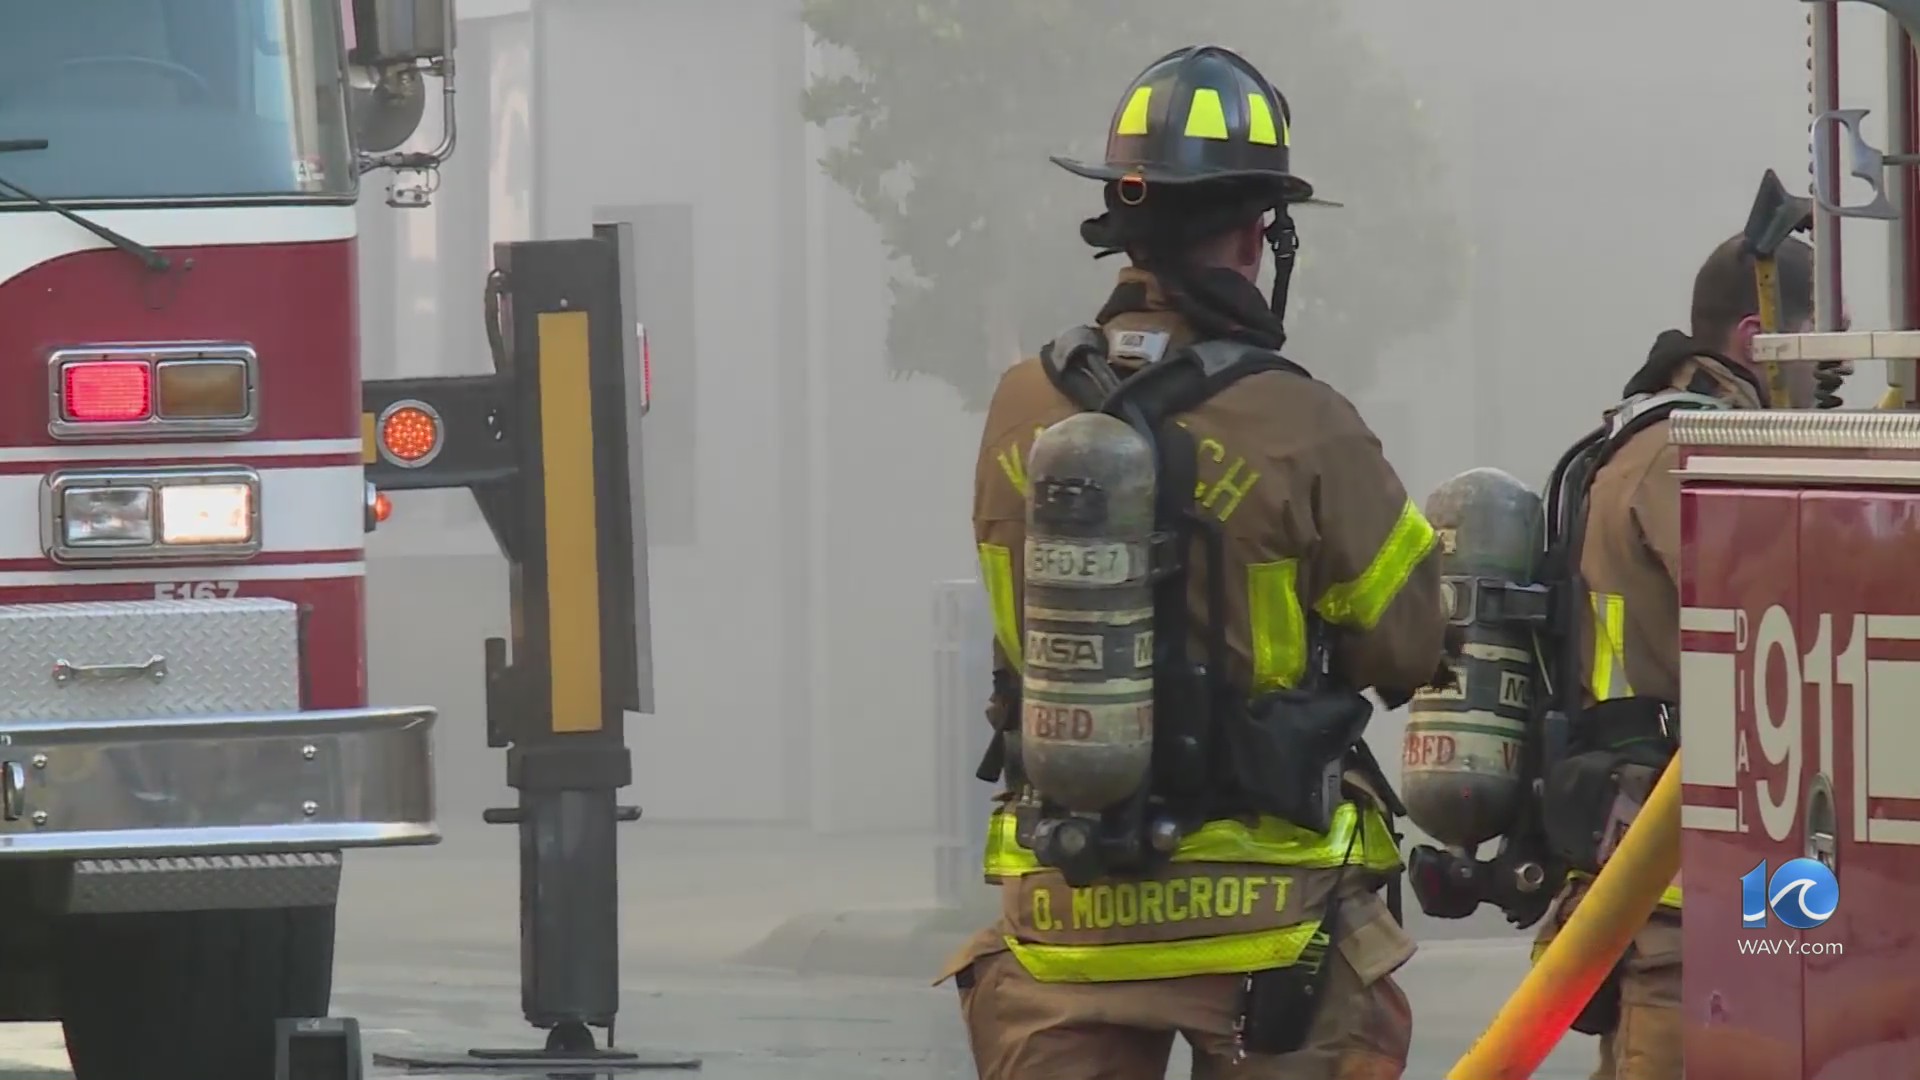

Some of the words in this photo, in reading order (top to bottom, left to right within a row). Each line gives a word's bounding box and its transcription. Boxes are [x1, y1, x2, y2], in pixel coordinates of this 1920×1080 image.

[1029, 636, 1098, 665] MSA
[1753, 604, 1868, 843] 911
[1406, 733, 1456, 766] BFD
[1071, 876, 1294, 930] MOORCROFT
